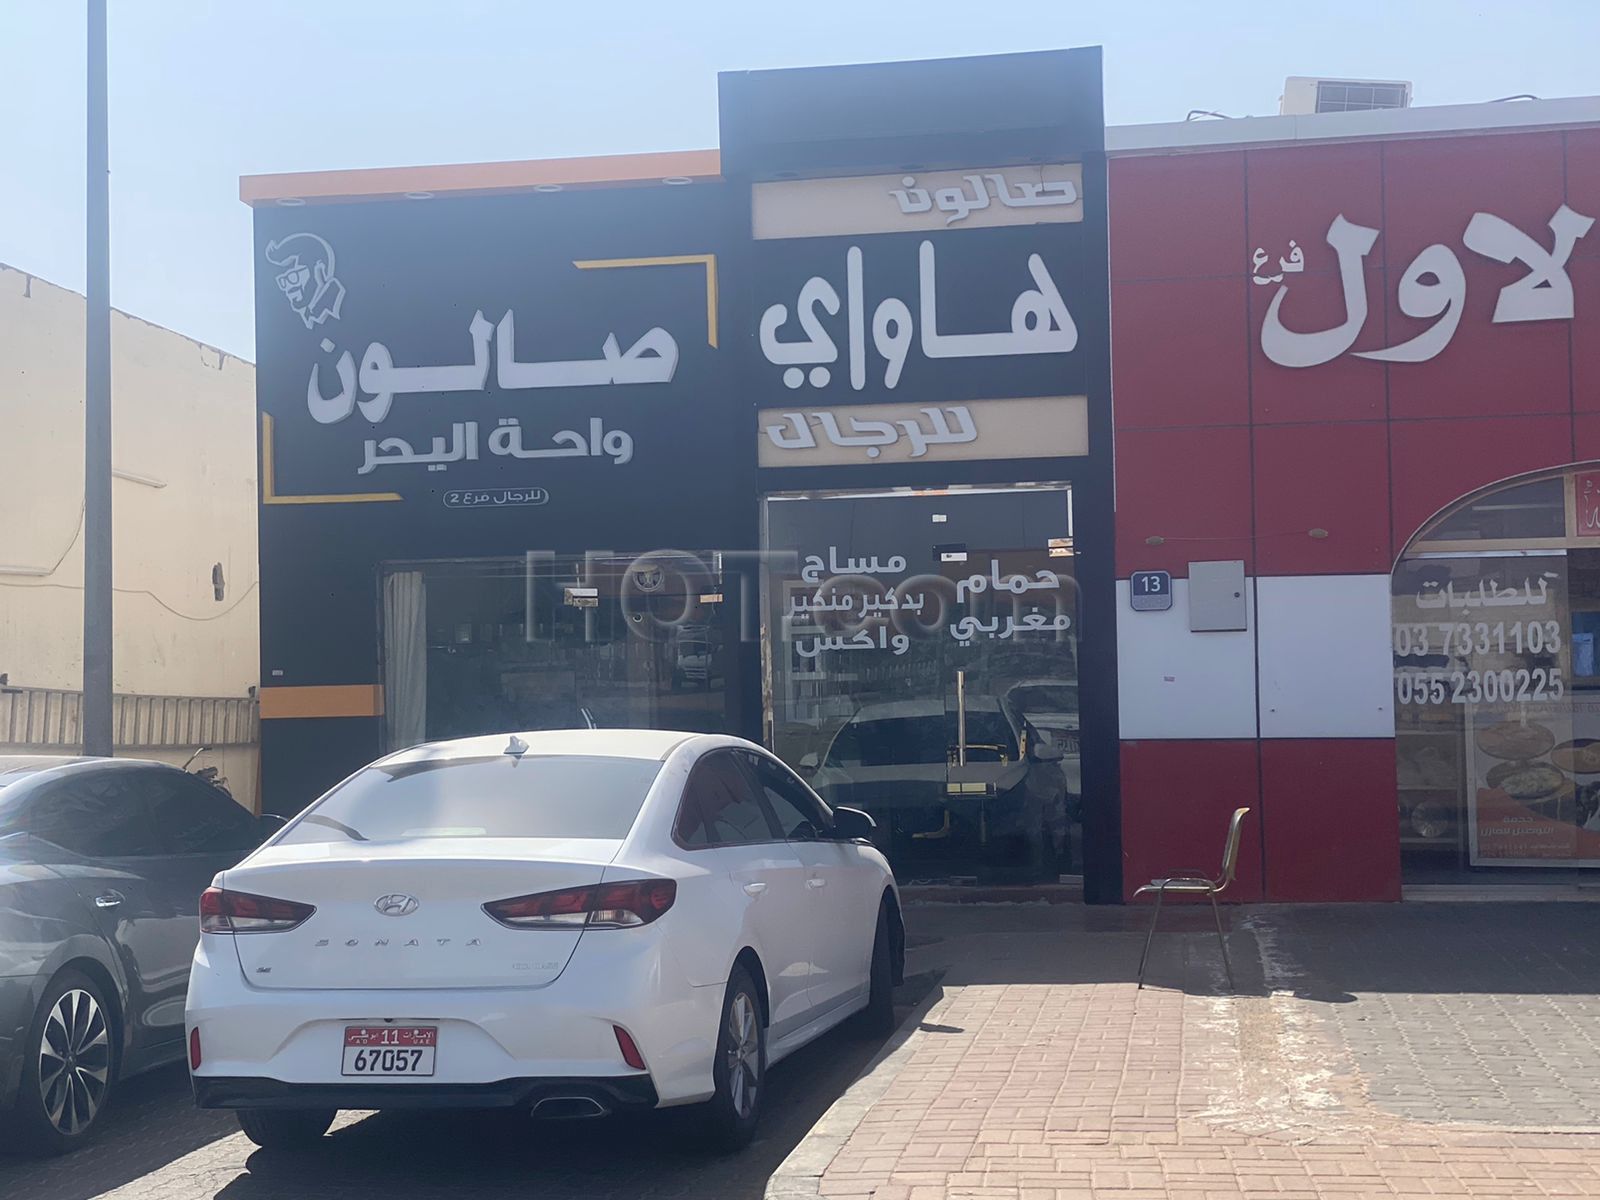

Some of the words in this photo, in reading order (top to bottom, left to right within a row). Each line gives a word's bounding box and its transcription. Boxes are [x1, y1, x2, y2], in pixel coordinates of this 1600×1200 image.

[888, 172, 1078, 225] صالون
[760, 240, 1078, 390] هاواي
[307, 308, 679, 425] صالون
[488, 417, 634, 464] واحة
[766, 405, 978, 458] للرجال
[450, 493, 460, 503] 2
[463, 492, 490, 504] فرع
[493, 490, 541, 504] للرجال
[801, 546, 907, 583] مساج
[957, 559, 1060, 603] حمام
[858, 587, 925, 618] بدكير
[1141, 575, 1161, 593] 13
[1416, 571, 1559, 615] للطلبات
[785, 587, 854, 619] منكير
[796, 626, 910, 657] واكس
[949, 606, 1071, 647] مغربي
[1394, 622, 1429, 658] 03
[1439, 619, 1562, 657] 7331103
[1397, 671, 1446, 705] 055
[1450, 668, 1565, 704] 2300225
[315, 938, 482, 948] SONATA
[380, 1029, 400, 1044] 11
[354, 1049, 424, 1072] 67057
